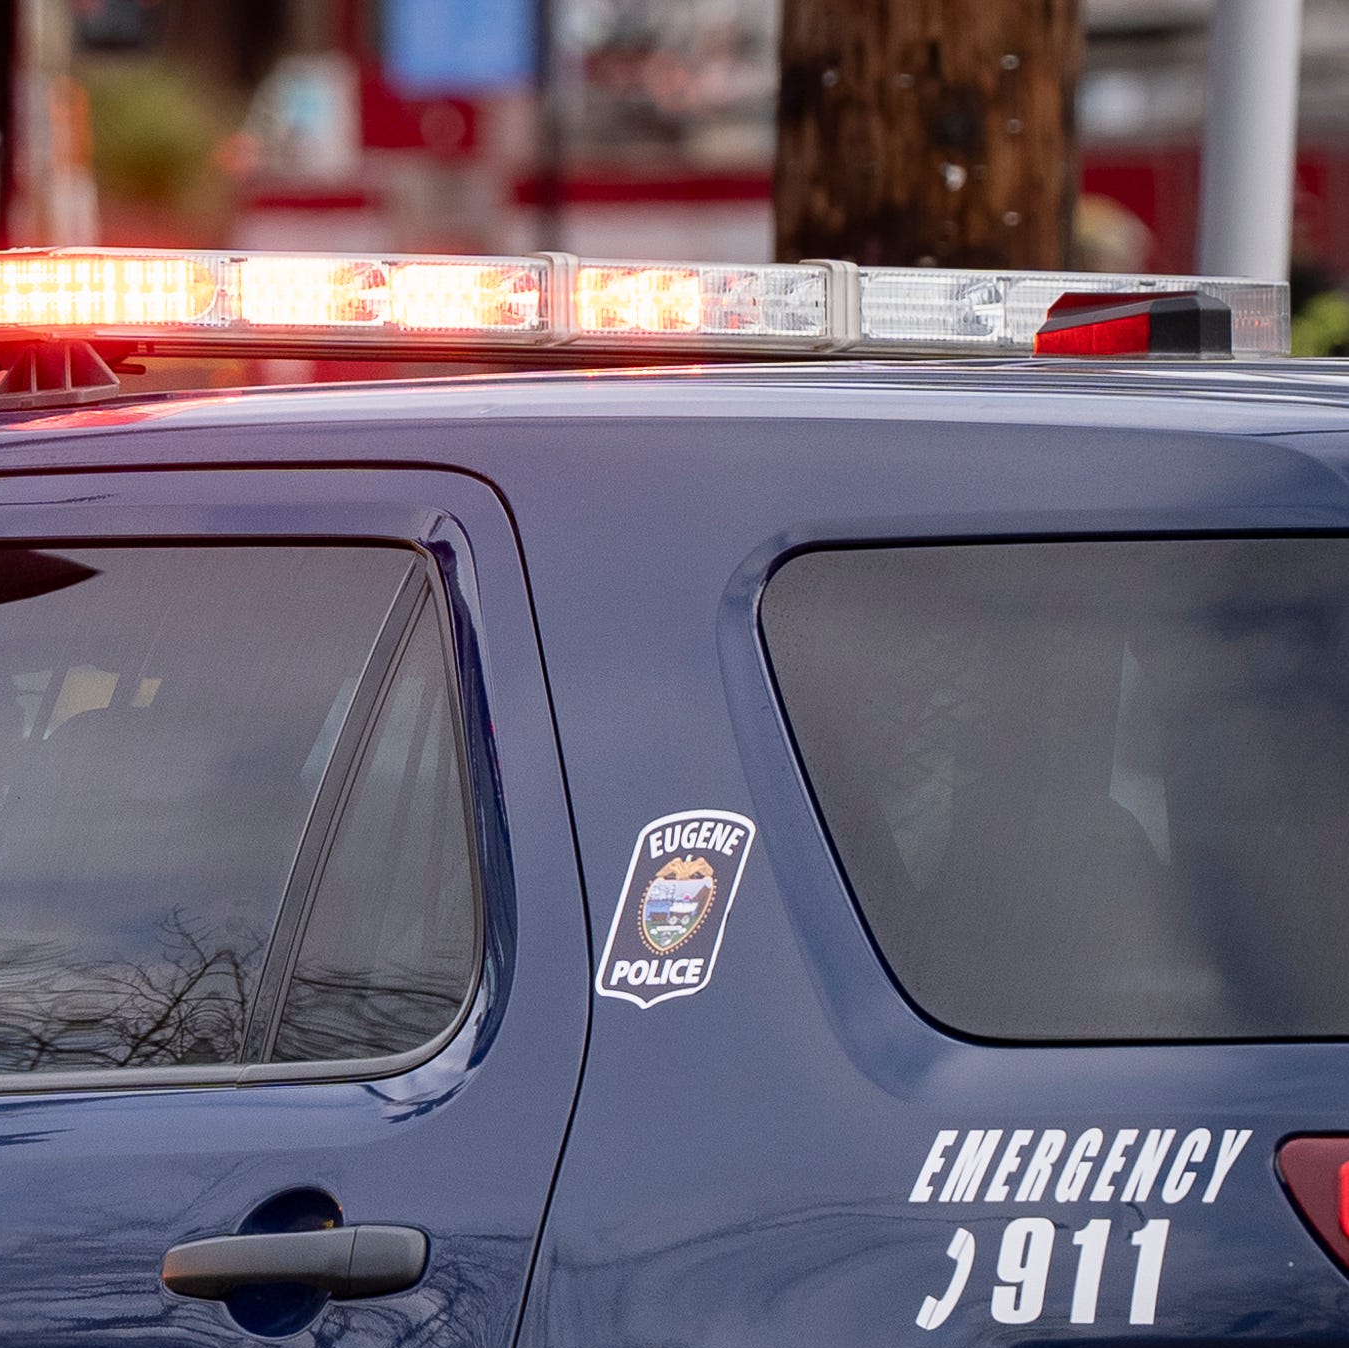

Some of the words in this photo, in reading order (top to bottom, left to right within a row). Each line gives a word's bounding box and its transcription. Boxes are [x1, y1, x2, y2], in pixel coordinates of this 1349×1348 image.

[649, 821, 745, 859] EUGENE
[609, 958, 704, 986] POLICE
[908, 1127, 1253, 1204] EMERGENCY
[990, 1217, 1170, 1325] 911
